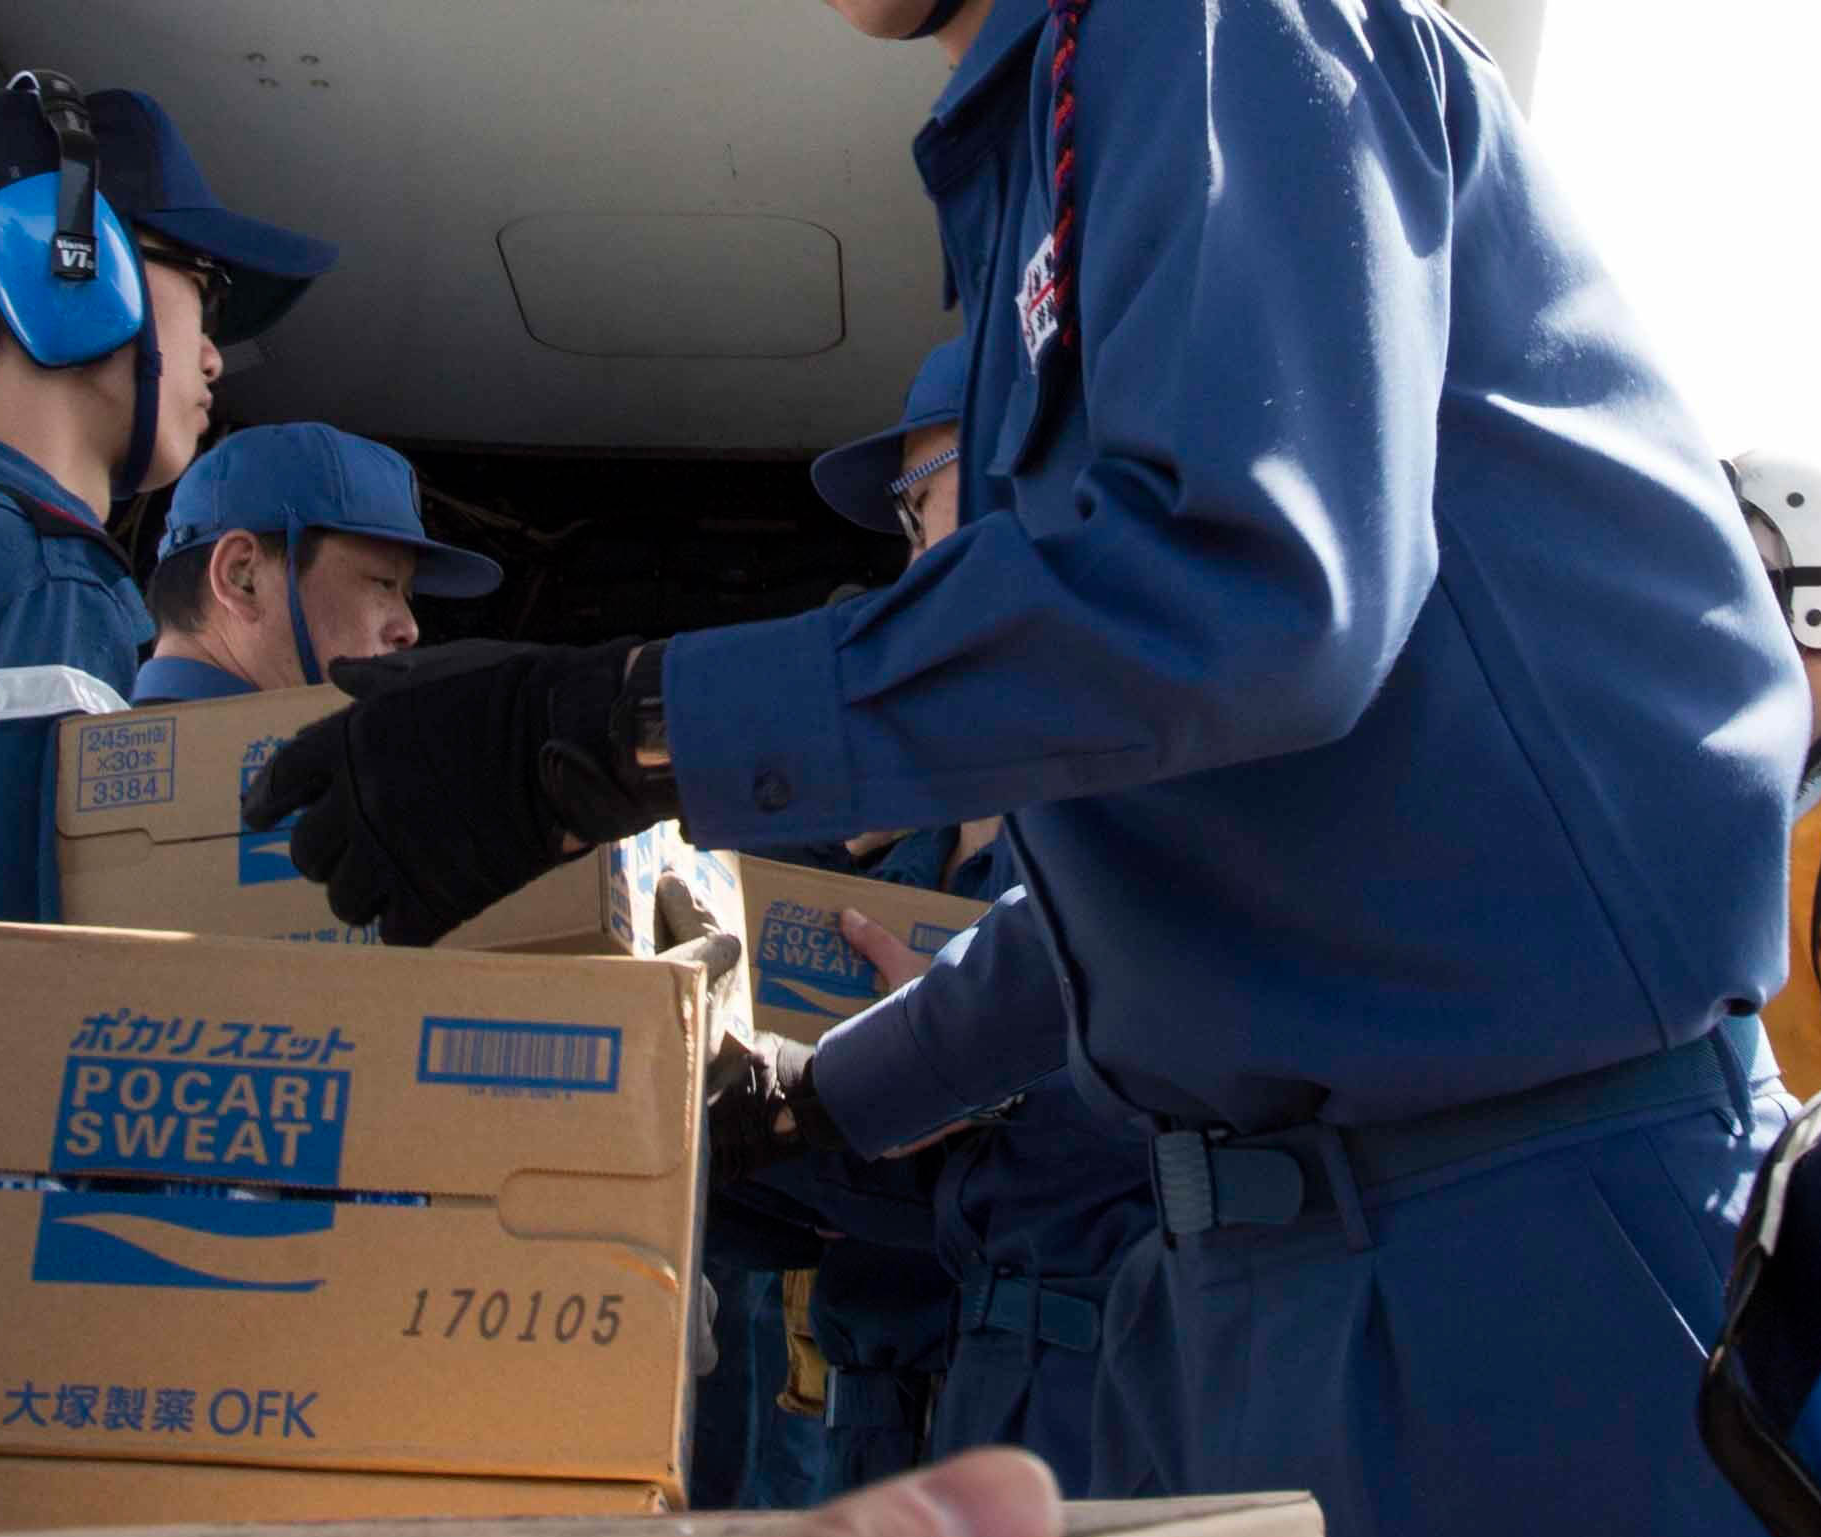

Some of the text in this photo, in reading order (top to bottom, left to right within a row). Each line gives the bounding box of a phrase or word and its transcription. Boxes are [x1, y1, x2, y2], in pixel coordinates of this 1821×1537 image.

[92, 776, 158, 804] 3384
[70, 1065, 341, 1123] POCARI
[65, 1111, 314, 1168] SWEAT
[400, 1287, 624, 1346] 170105
[208, 1388, 320, 1439] OFK
